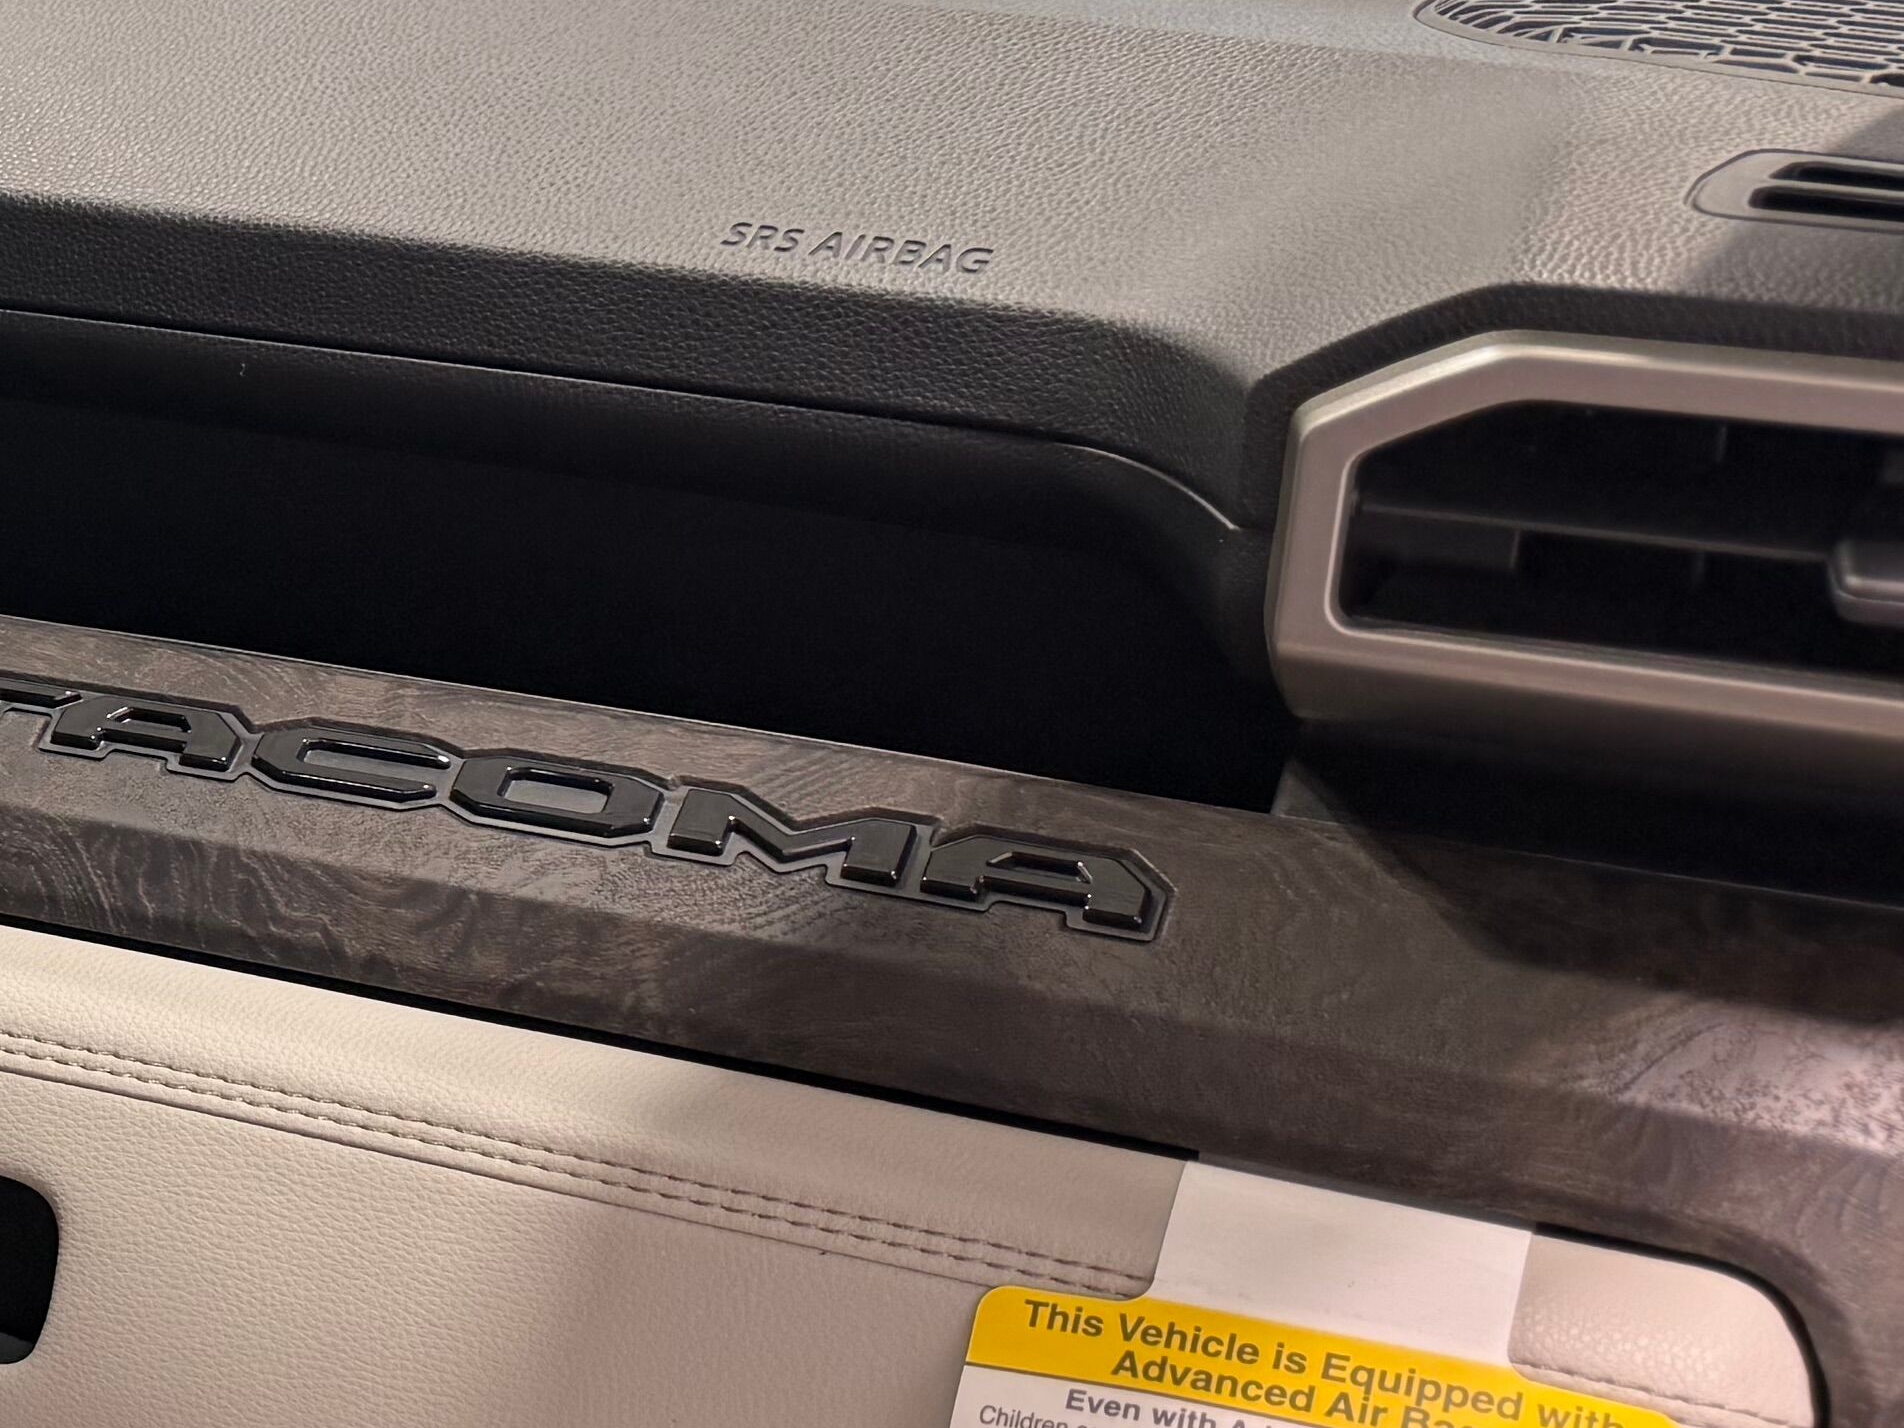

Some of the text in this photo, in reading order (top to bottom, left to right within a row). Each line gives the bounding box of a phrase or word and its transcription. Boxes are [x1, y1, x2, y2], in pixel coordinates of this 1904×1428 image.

[720, 222, 994, 273] SRS AIRBAG
[1025, 1299, 1104, 1337] This
[1119, 1312, 1260, 1365] Vehicle
[1272, 1342, 1307, 1374] is
[1321, 1352, 1523, 1421] Equipped
[1111, 1350, 1315, 1413] Advanced
[1325, 1391, 1388, 1427] Air
[1066, 1389, 1141, 1421] Even
